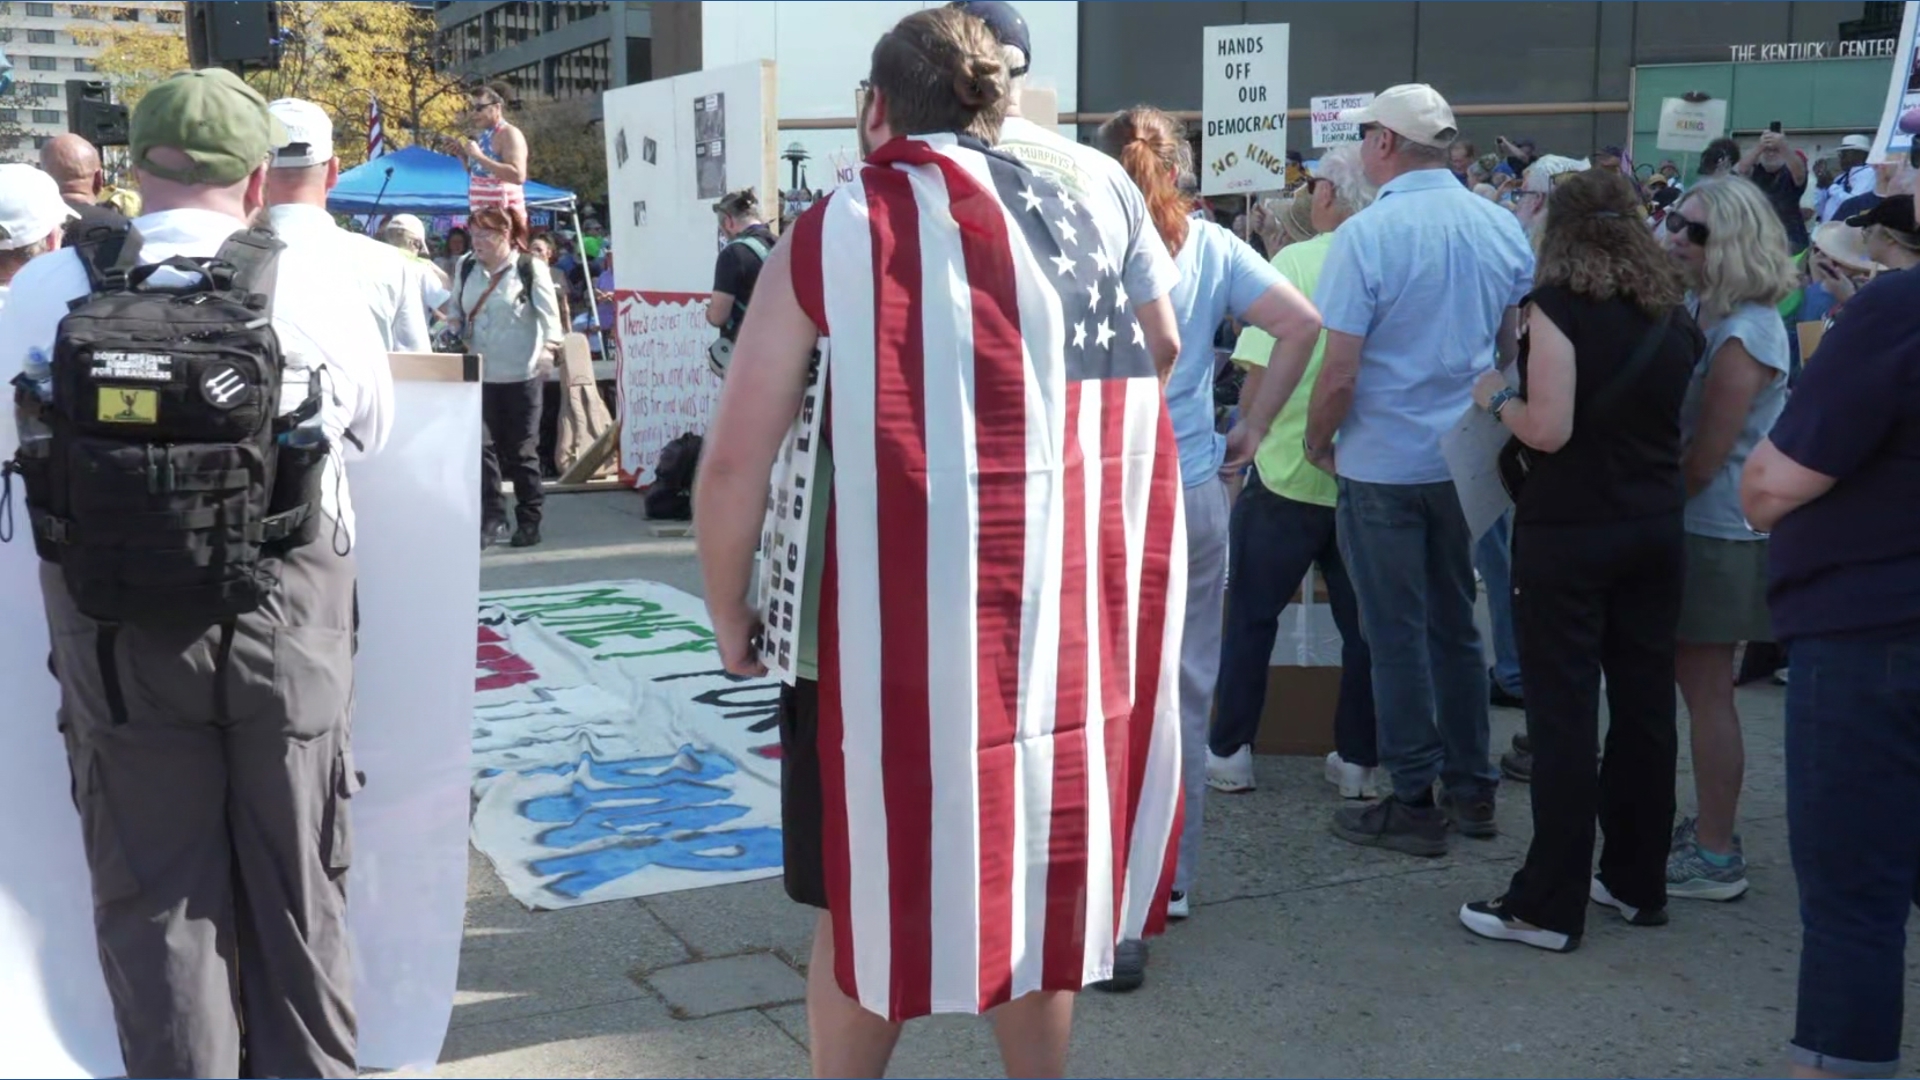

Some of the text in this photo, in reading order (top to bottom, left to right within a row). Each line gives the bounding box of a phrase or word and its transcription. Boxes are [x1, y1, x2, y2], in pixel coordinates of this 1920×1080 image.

[1218, 36, 1263, 56] HANDS
[1730, 39, 1895, 62] THE KENTUCKY CENTER
[1225, 62, 1251, 80] OFF
[1239, 85, 1267, 103] OUR
[1321, 97, 1362, 110] THE MOST
[1208, 113, 1285, 137] DEMOCRACY
[1313, 111, 1342, 122] VIOLEN
[1019, 147, 1070, 169] MURPHYS
[1211, 151, 1239, 177] NO
[837, 168, 854, 183] NO
